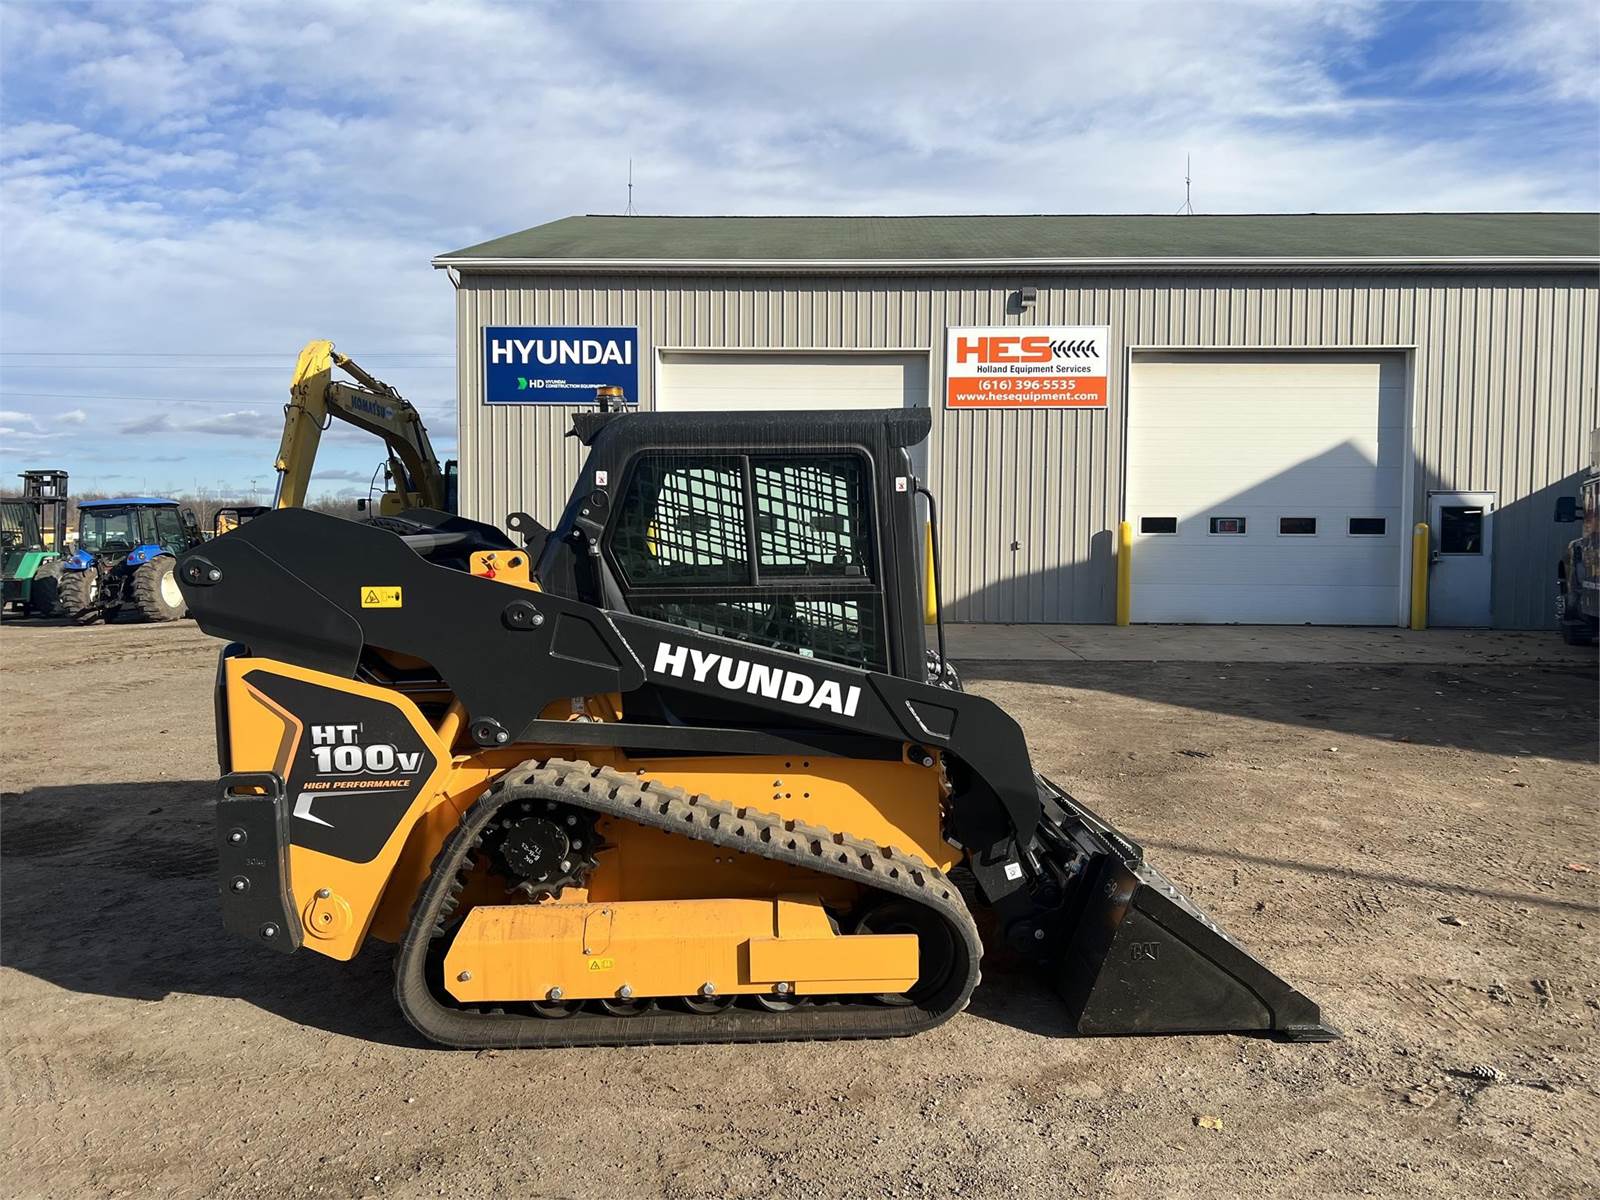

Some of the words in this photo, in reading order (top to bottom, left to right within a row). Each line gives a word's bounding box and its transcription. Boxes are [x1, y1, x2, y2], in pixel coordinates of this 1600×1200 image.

[492, 339, 632, 365] HYUNDAI
[956, 336, 1053, 363] HES
[977, 365, 1008, 374] Holland
[1010, 365, 1054, 375] Equipment
[1056, 365, 1092, 373] Services
[529, 379, 545, 389] HD
[978, 379, 1012, 391] (616)
[1015, 379, 1076, 390] 396-5535
[351, 395, 386, 419] KOMATSU
[956, 391, 1099, 403] www.hesequipment.com
[653, 641, 861, 718] HYUNDAI
[311, 724, 359, 745] HT
[303, 780, 331, 790] HIGH
[333, 779, 411, 789] PERFORMANCE
[1129, 941, 1161, 961] CAT
